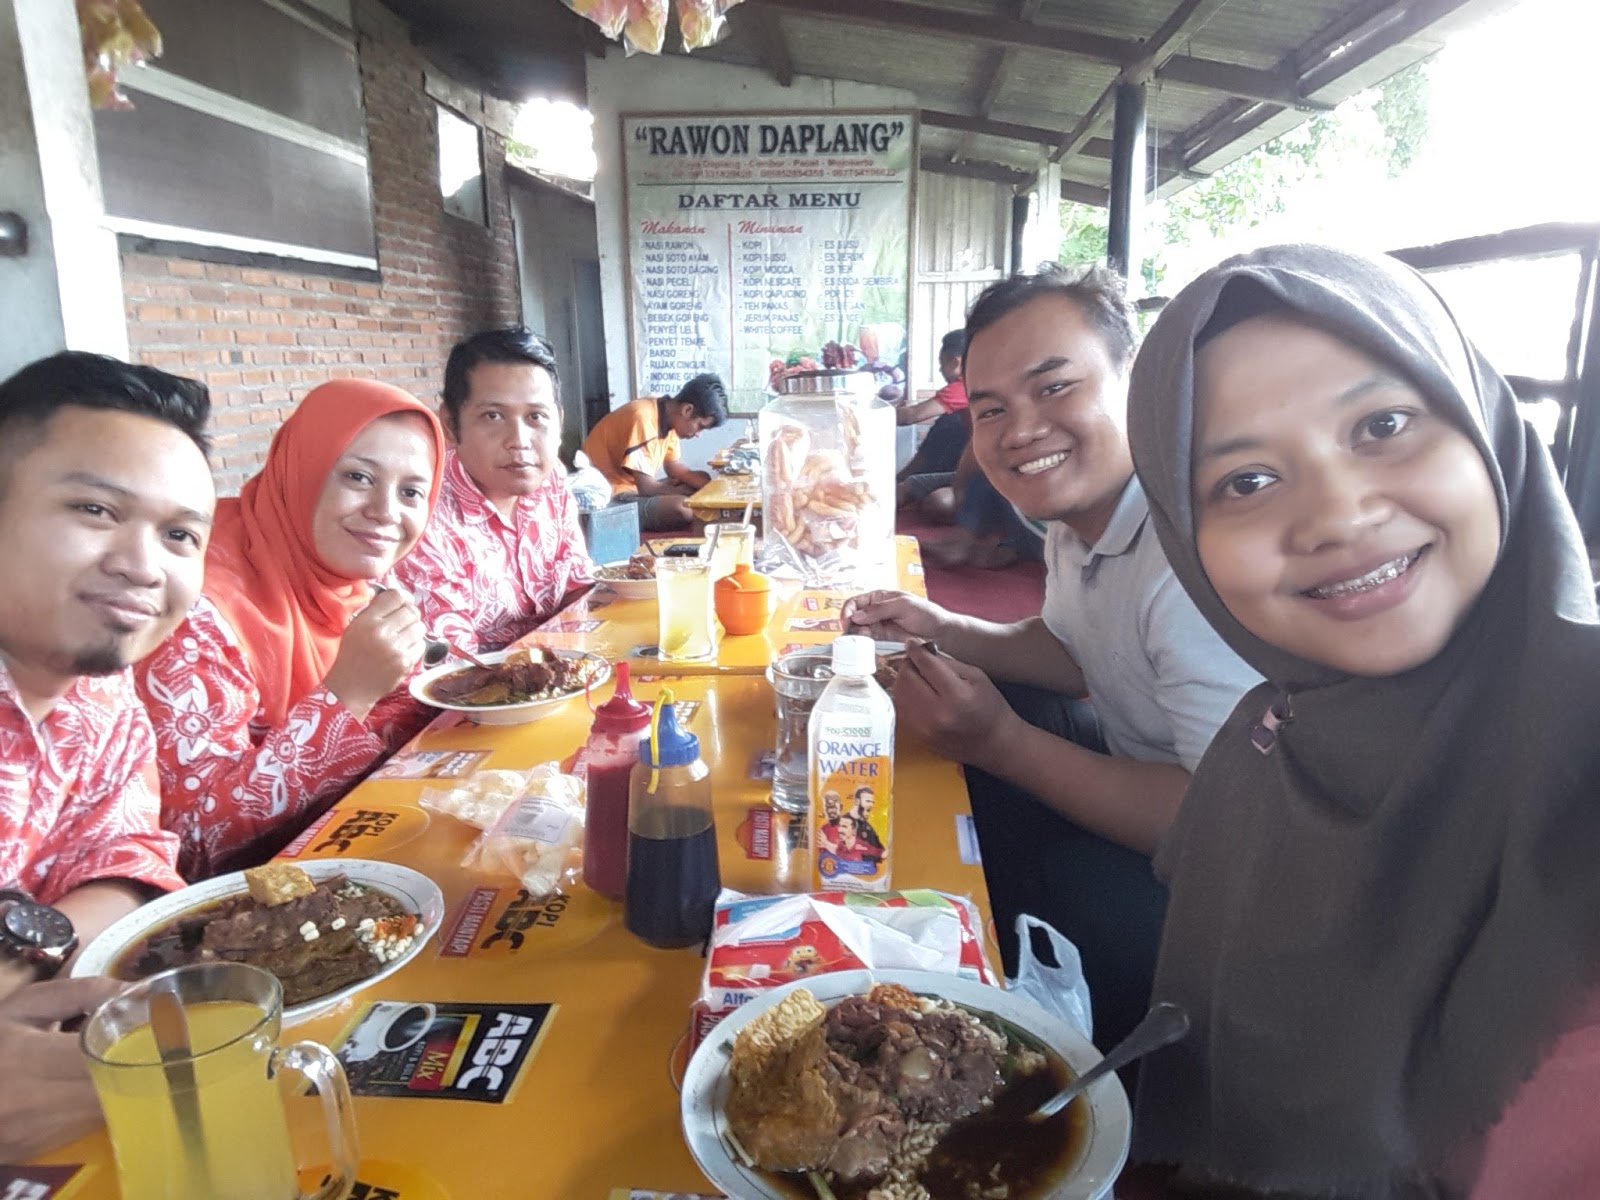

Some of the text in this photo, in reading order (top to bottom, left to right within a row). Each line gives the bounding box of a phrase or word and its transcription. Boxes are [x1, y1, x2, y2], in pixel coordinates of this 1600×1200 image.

[635, 121, 904, 155] “RAWON DAPLANG”
[679, 192, 862, 209] DAFTAR MENU
[641, 221, 706, 234] Makanan
[737, 220, 803, 234] Minuman
[645, 241, 694, 250] NASI RAWON
[742, 241, 762, 249] KOPI
[824, 240, 835, 249] ES
[645, 253, 709, 262] NASI SOTO AYAM
[742, 253, 762, 262] KOPI
[824, 252, 835, 261] ES
[646, 265, 719, 274] NASI SOTO DAGING
[742, 265, 762, 274] KOPI
[824, 265, 835, 274] ES
[646, 278, 692, 287] NASI PECEL
[743, 277, 763, 286] KOPI
[824, 277, 835, 286] ES
[647, 290, 701, 298] NASI GORENG
[743, 289, 764, 298] KOPI
[744, 302, 761, 310] TEH
[648, 314, 674, 322] BEBEK
[648, 326, 678, 334] PENYET
[648, 338, 678, 346] PENYET
[649, 349, 676, 358] BAKSO
[816, 740, 882, 758] ORANGE
[818, 759, 879, 777] WATER
[365, 811, 400, 837] KOPI
[312, 810, 382, 853] ABC
[536, 894, 571, 927] KOPI
[456, 1012, 534, 1091] ABC
[416, 1050, 449, 1081] Mix
